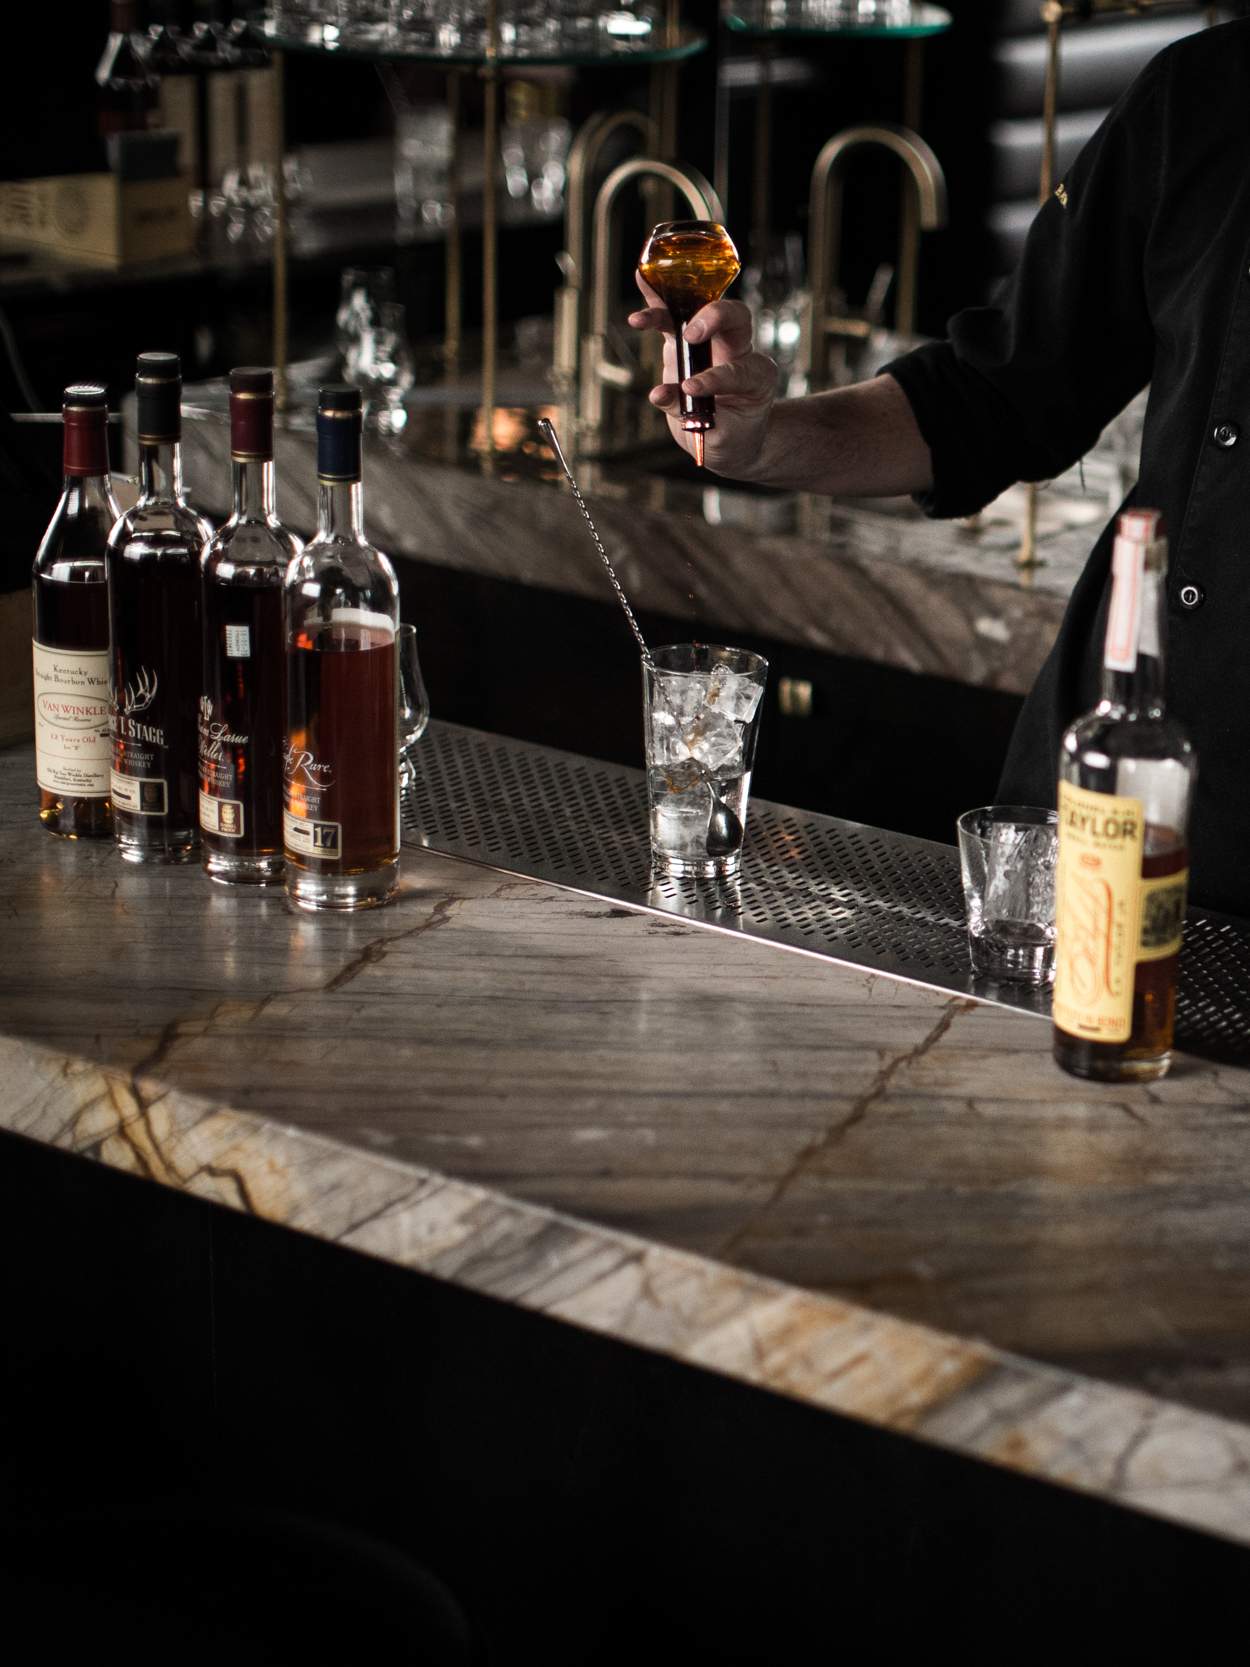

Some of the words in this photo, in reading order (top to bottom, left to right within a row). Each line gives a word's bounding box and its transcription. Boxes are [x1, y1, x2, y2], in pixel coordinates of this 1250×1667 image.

[53, 664, 88, 676] Kentucky
[54, 675, 85, 686] Bourbon
[87, 677, 108, 686] Whis
[42, 700, 60, 712] VAN
[61, 704, 106, 716] WINKLE
[128, 718, 164, 746] STAGG
[60, 734, 80, 743] Years
[123, 751, 154, 761] STRAIGHT
[314, 826, 336, 847] 17
